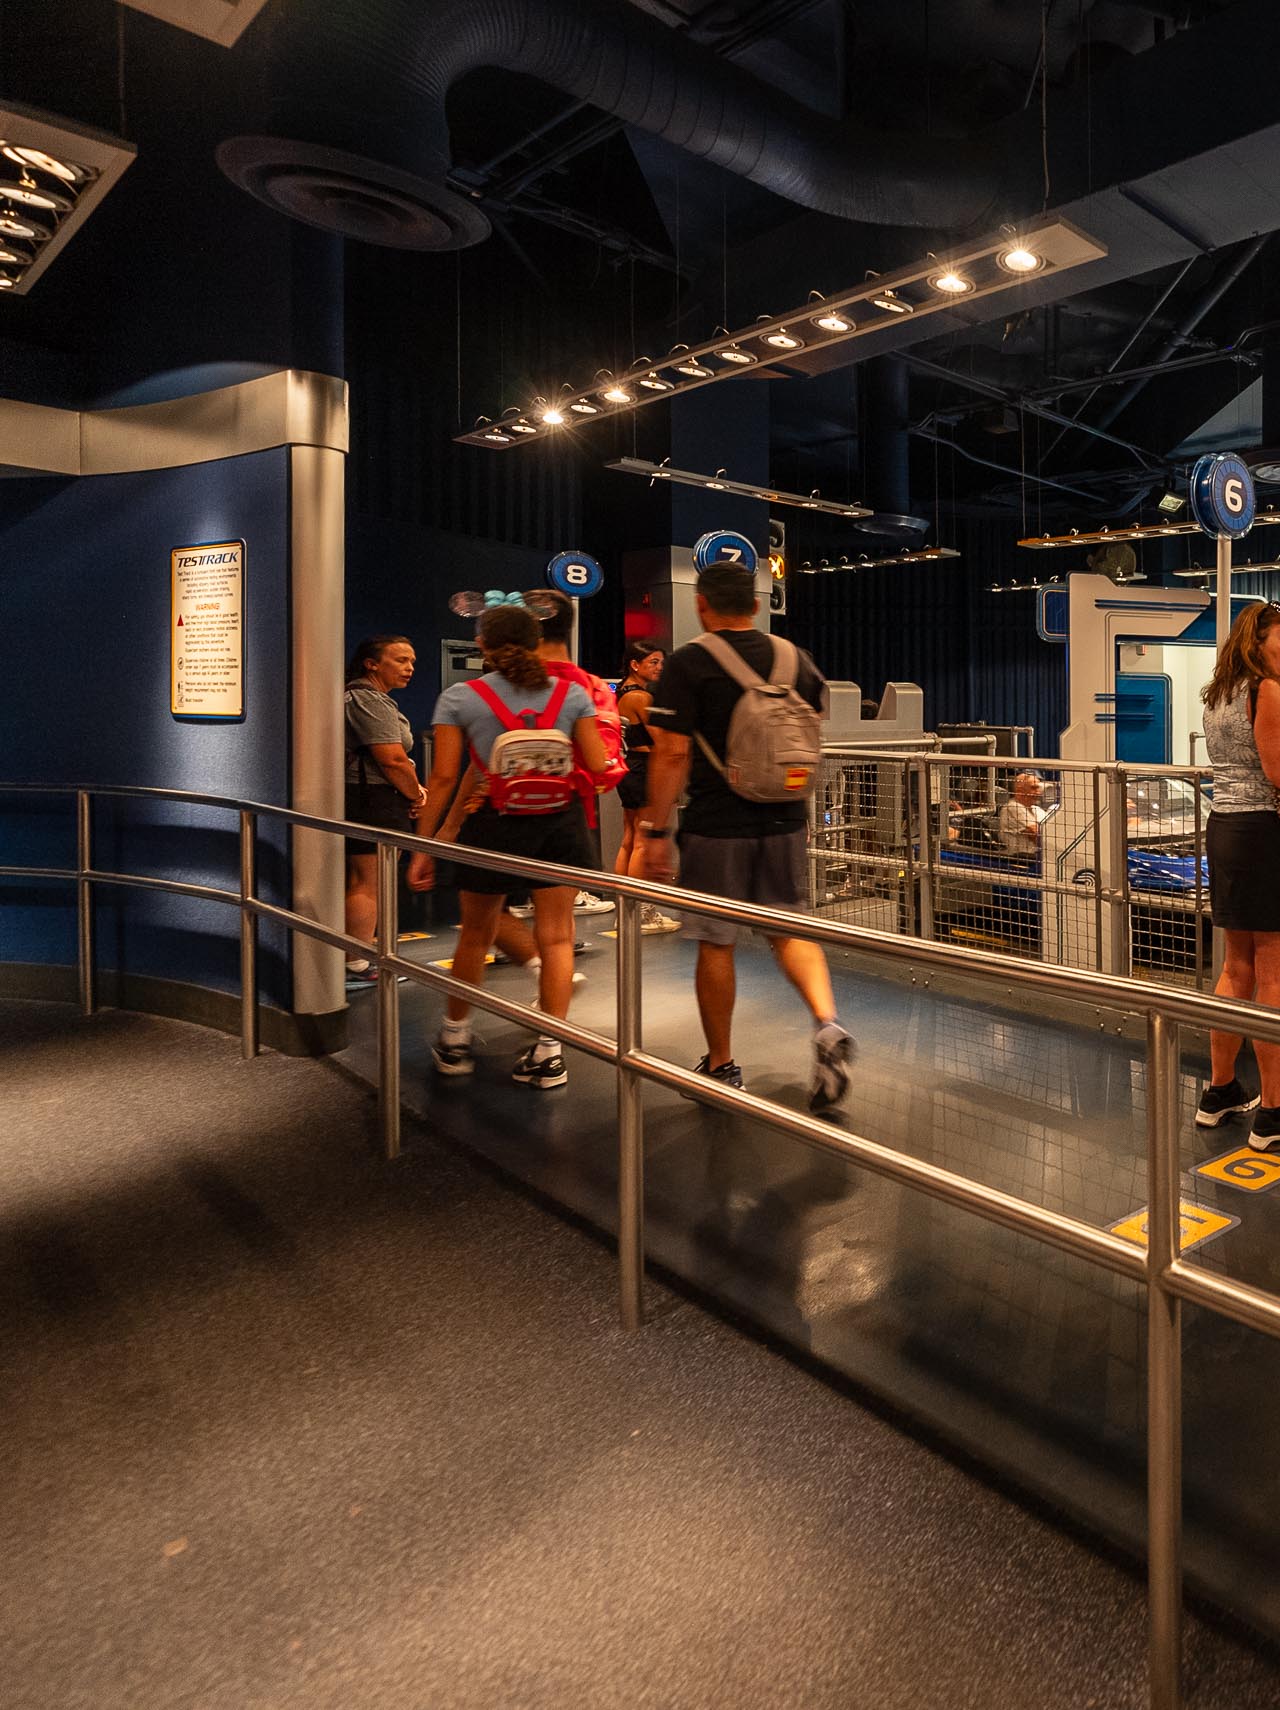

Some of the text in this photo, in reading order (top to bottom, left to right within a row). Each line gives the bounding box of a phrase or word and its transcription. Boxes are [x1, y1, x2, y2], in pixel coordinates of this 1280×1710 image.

[1225, 478, 1243, 513] 6
[721, 547, 742, 562] 7
[566, 564, 588, 584] 8
